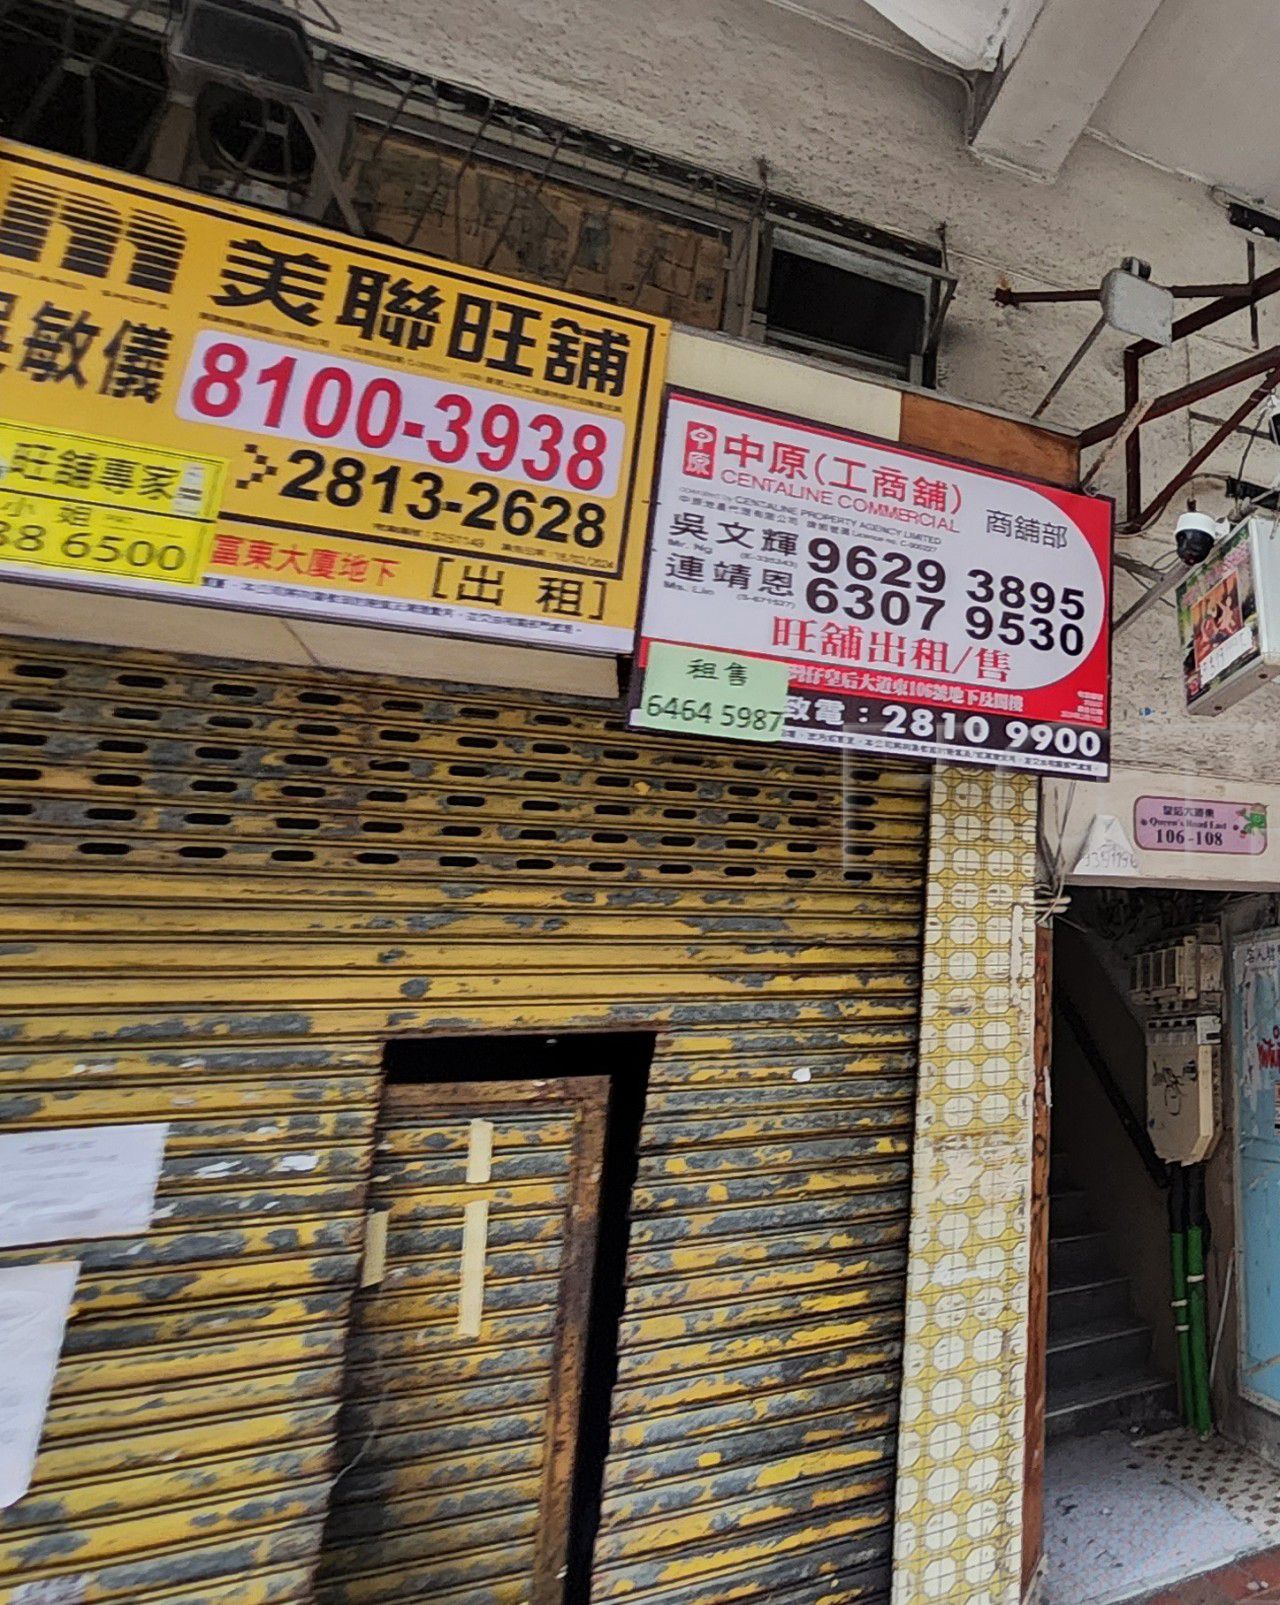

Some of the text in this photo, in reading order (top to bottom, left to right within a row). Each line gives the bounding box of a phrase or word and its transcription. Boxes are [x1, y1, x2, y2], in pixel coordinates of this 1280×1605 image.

[211, 239, 631, 398] 美聯旺舖
[191, 343, 608, 492] 8100-3938
[286, 448, 607, 549] 2813-2628
[721, 469, 834, 505] CENTALINE
[837, 494, 960, 534] COMMERCIAL
[723, 433, 962, 515] 中原(工商舖)
[61, 532, 186, 571] 6500
[800, 509, 857, 527] PROPERTY
[903, 531, 942, 545] LIMITED
[986, 508, 1069, 551] 商舖部
[669, 512, 1086, 621] 吳文輝 9629 3895
[665, 552, 1084, 656] 連靖恩 6307 9530
[772, 615, 1012, 683] 旺舖出租/售
[646, 695, 783, 732] 6464 5987
[882, 704, 990, 743] 2810
[1005, 721, 1101, 758] 9900
[1149, 816, 1227, 830] Queen's Road East
[1162, 804, 1215, 819] 皇后大道東
